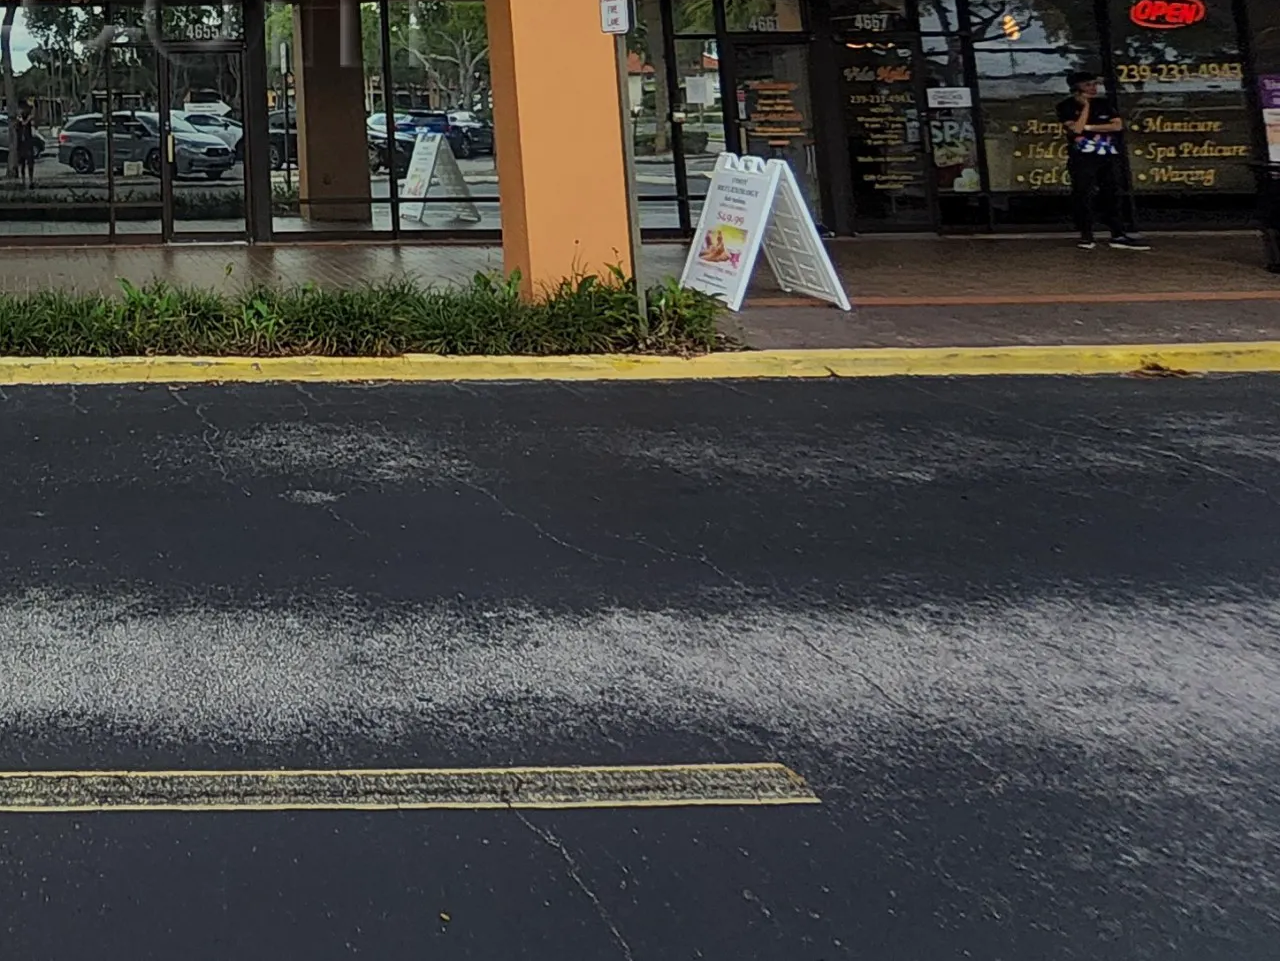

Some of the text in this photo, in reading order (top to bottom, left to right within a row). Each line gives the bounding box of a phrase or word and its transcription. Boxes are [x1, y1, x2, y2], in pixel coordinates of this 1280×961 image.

[854, 13, 889, 30] 4667
[186, 23, 220, 40] 4655
[1116, 62, 1244, 84] 239-231-4943
[1143, 116, 1222, 134] Manicure
[1145, 141, 1249, 164] Spa Pedicure
[1029, 168, 1058, 187] Gel
[1149, 166, 1215, 187] Waxing
